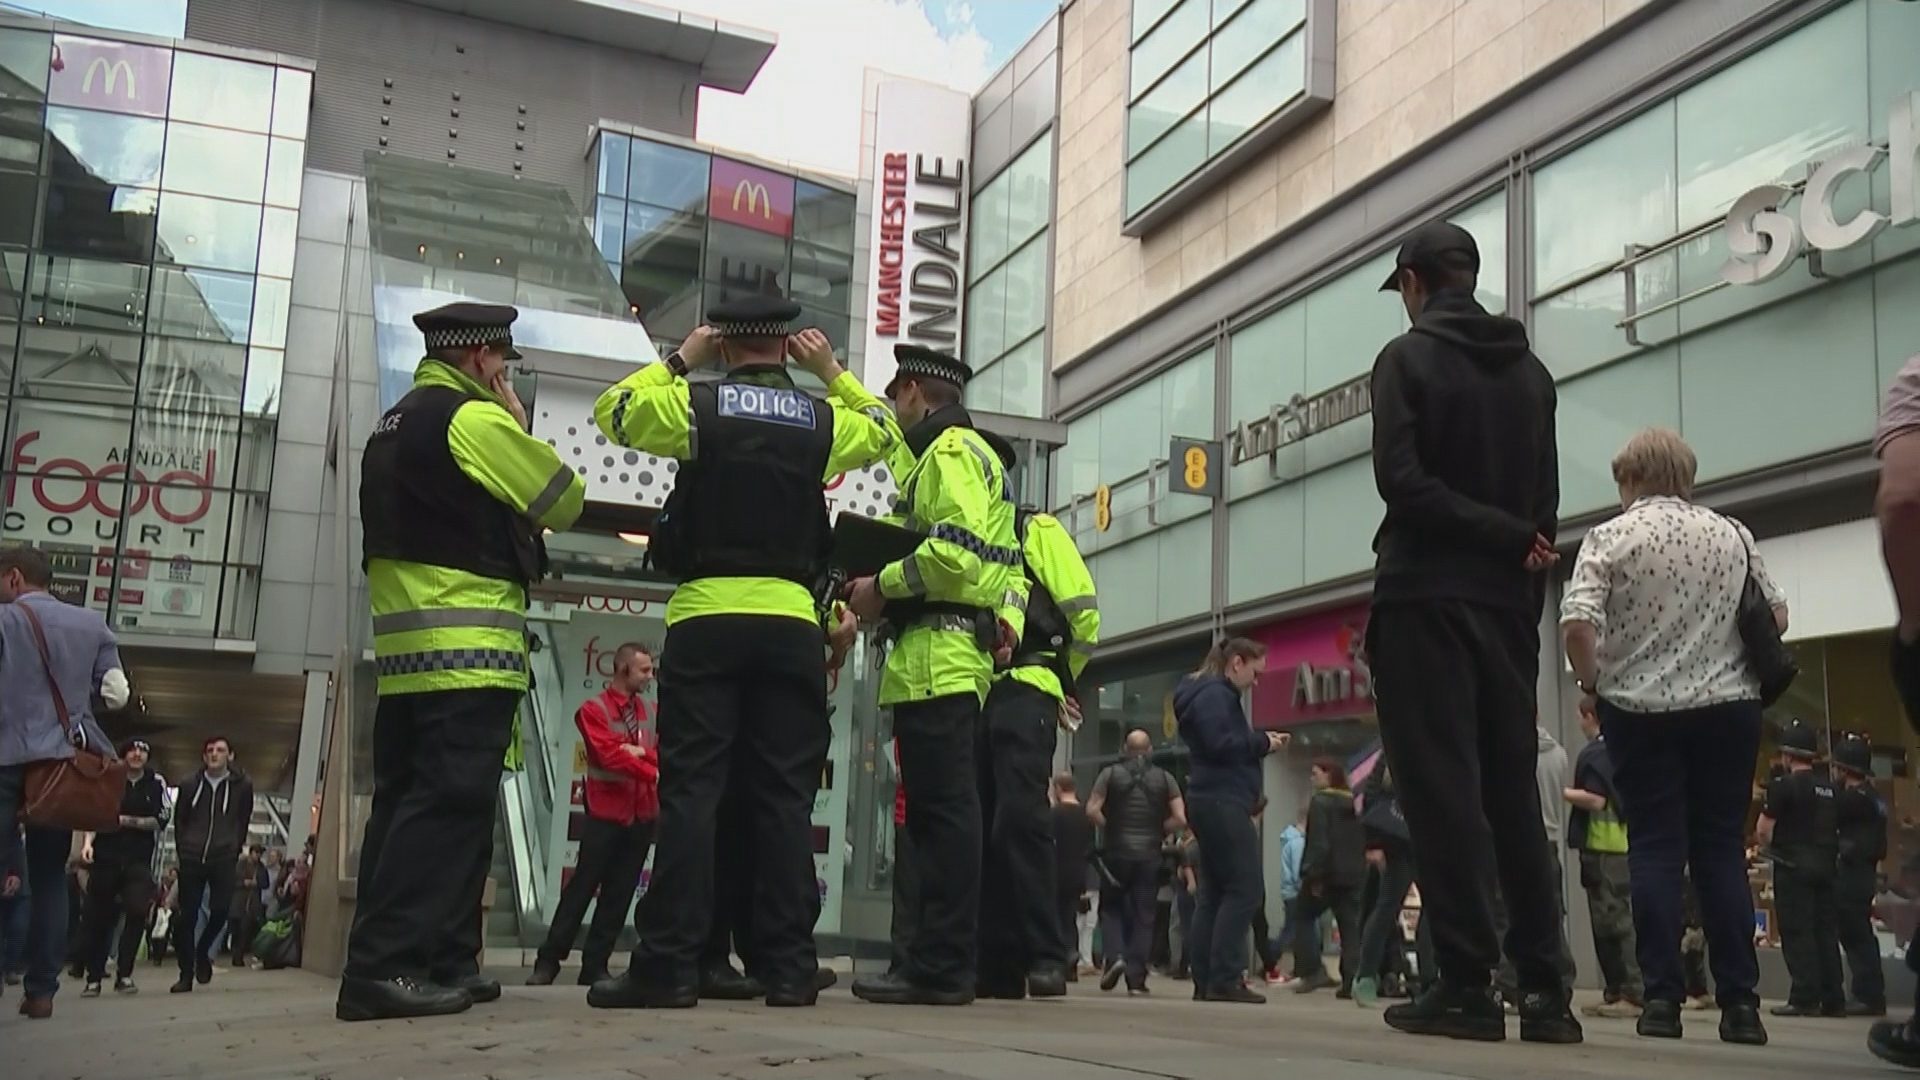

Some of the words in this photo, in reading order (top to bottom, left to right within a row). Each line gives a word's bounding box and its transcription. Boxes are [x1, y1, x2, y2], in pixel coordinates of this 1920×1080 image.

[876, 152, 907, 337] MANCHESTER
[908, 153, 964, 357] NDALE
[723, 388, 811, 420] POLICE
[7, 430, 216, 525] food
[3, 512, 204, 547] COURT
[1291, 661, 1351, 707] Ann
